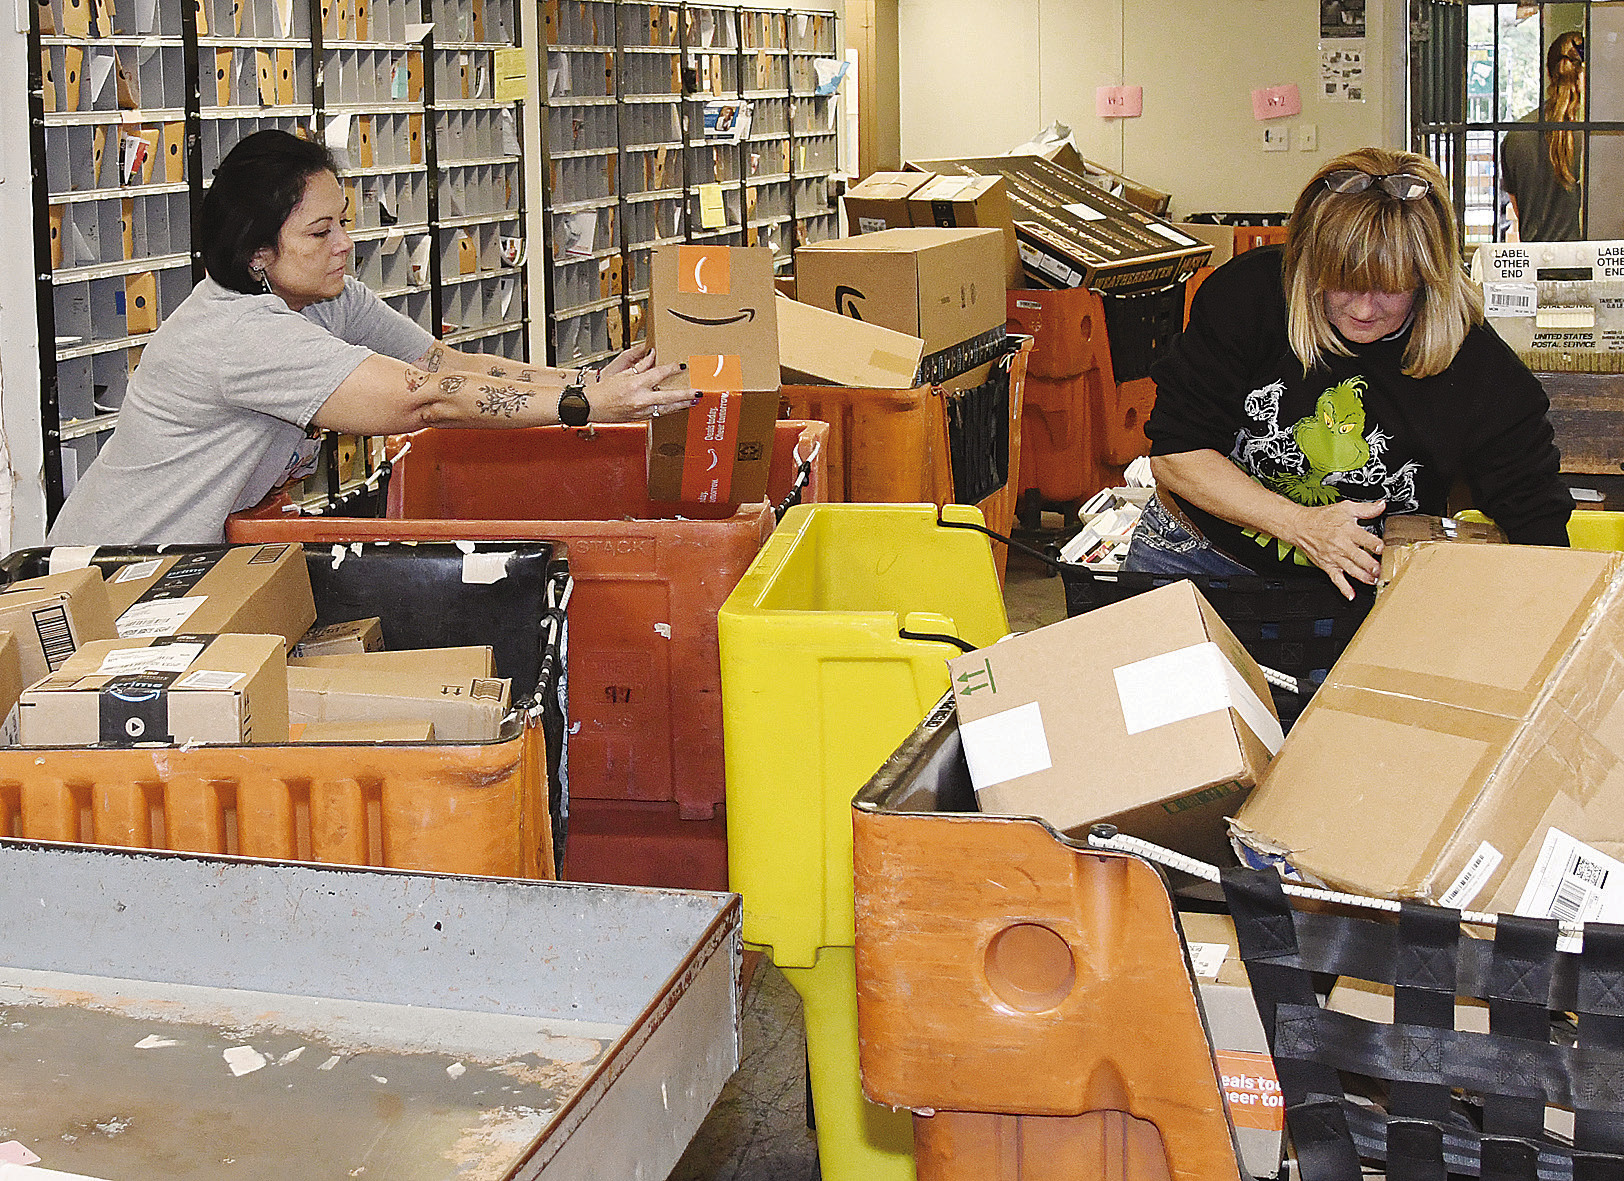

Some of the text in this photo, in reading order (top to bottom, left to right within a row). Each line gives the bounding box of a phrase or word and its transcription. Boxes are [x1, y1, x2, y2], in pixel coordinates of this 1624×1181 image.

[1494, 249, 1530, 259] LABEL
[1597, 247, 1624, 257] LABE
[1493, 259, 1530, 269] OTHER
[1596, 257, 1624, 267] OTHE
[1501, 269, 1523, 278] END
[1563, 332, 1593, 340] STATES
[1563, 340, 1597, 348] SERVICE
[704, 426, 716, 441] Deals
[714, 424, 725, 441] Cheer
[576, 540, 646, 555] STACK
[109, 680, 164, 691] prime
[1221, 1073, 1255, 1089] eals
[1225, 1091, 1259, 1105] eer
